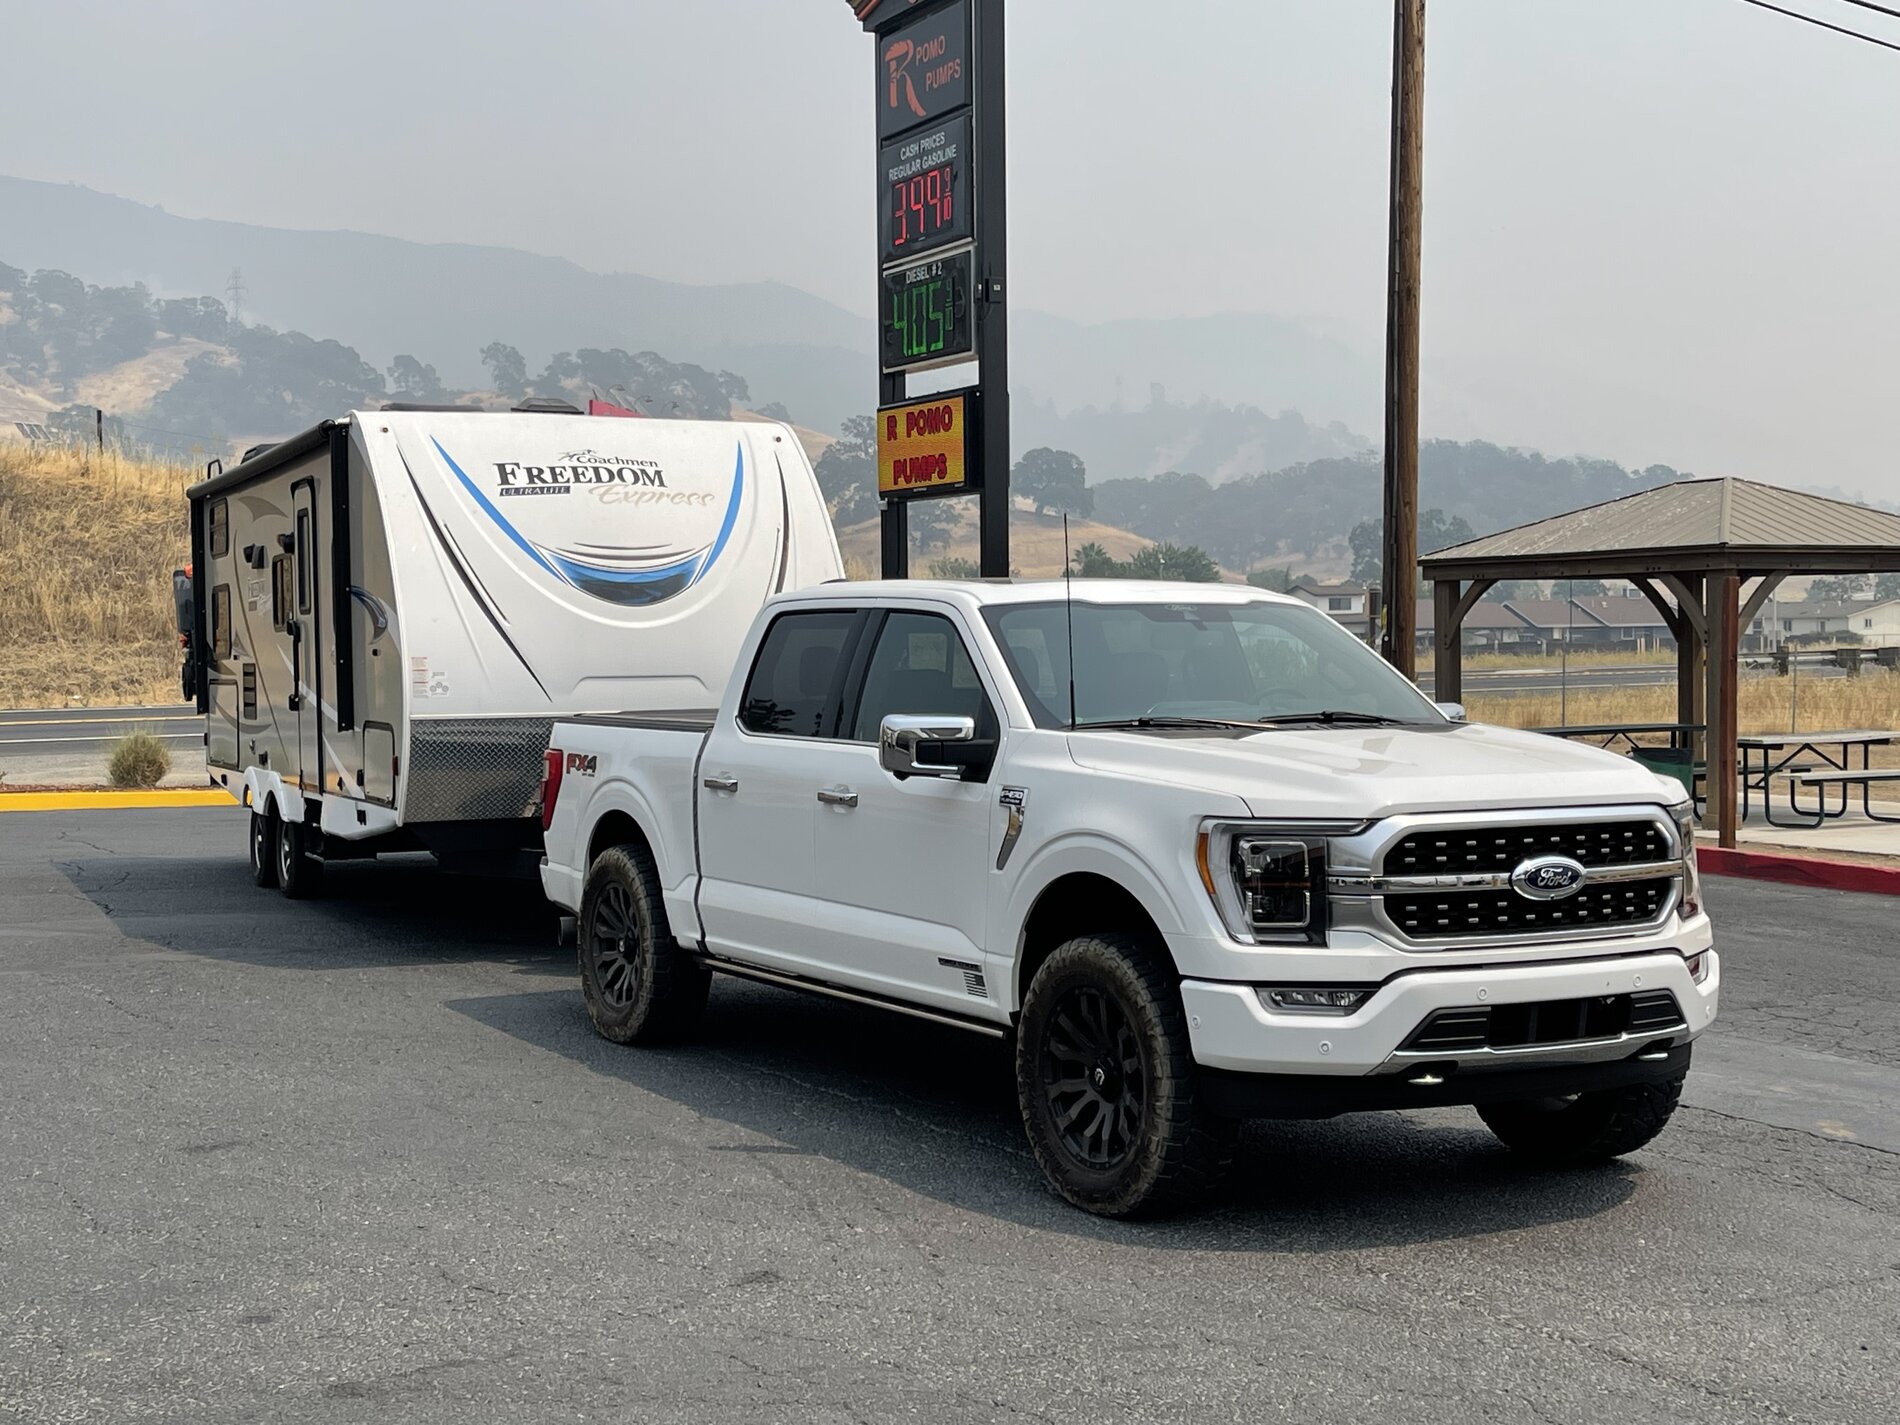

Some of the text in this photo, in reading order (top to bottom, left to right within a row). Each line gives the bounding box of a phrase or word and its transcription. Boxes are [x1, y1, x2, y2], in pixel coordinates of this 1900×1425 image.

[915, 35, 946, 67] POMO
[885, 39, 926, 117] R
[925, 58, 961, 92] PUMPS
[900, 131, 946, 161] CASH PRICES
[888, 143, 957, 182] REGULAR GASOLINE
[905, 266, 930, 284] DIESEL
[886, 404, 953, 442] R POMO
[576, 455, 659, 468] Coachmen
[893, 453, 948, 486] PUMPS
[589, 485, 716, 507] Express
[566, 752, 597, 775] FX4
[1537, 867, 1572, 887] Ford
